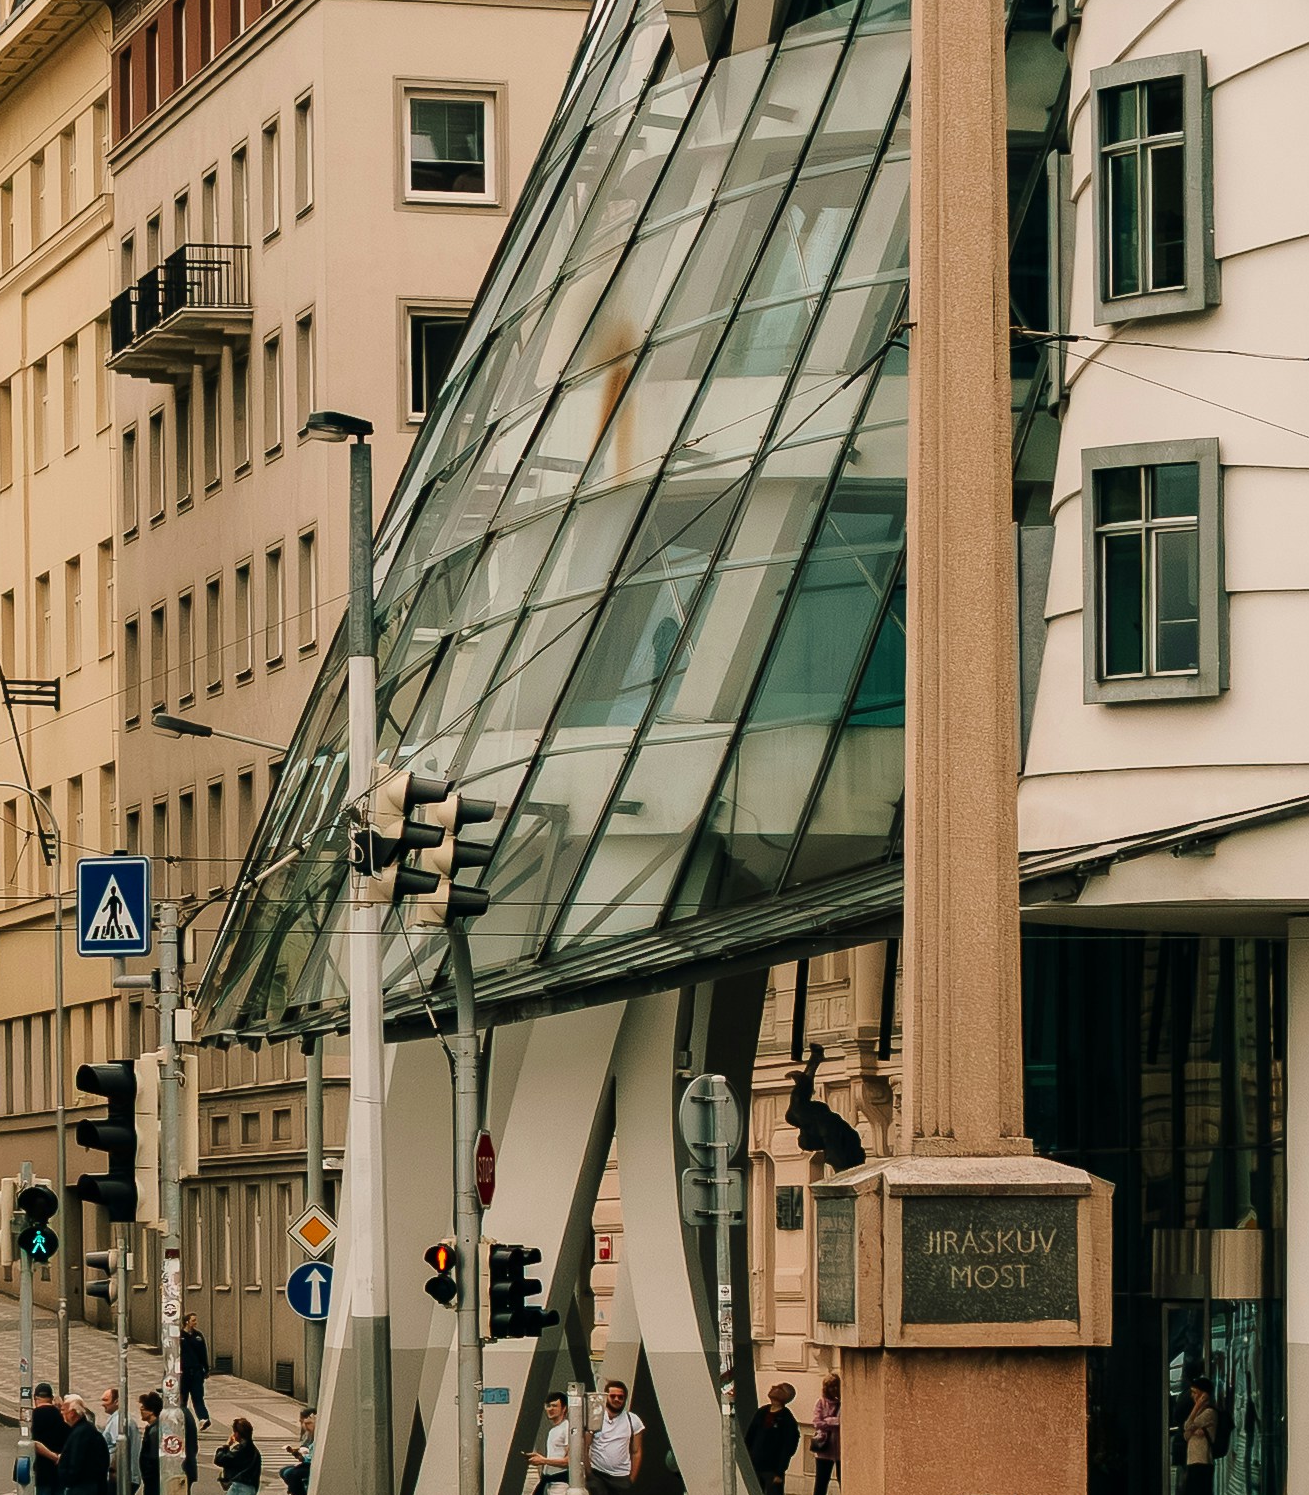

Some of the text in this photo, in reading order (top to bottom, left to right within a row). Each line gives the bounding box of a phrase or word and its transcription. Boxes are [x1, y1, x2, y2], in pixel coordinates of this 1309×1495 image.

[478, 1156, 494, 1183] STOP
[923, 1220, 1057, 1256] JIRÁSKŮV
[950, 1264, 1031, 1289] MOST
